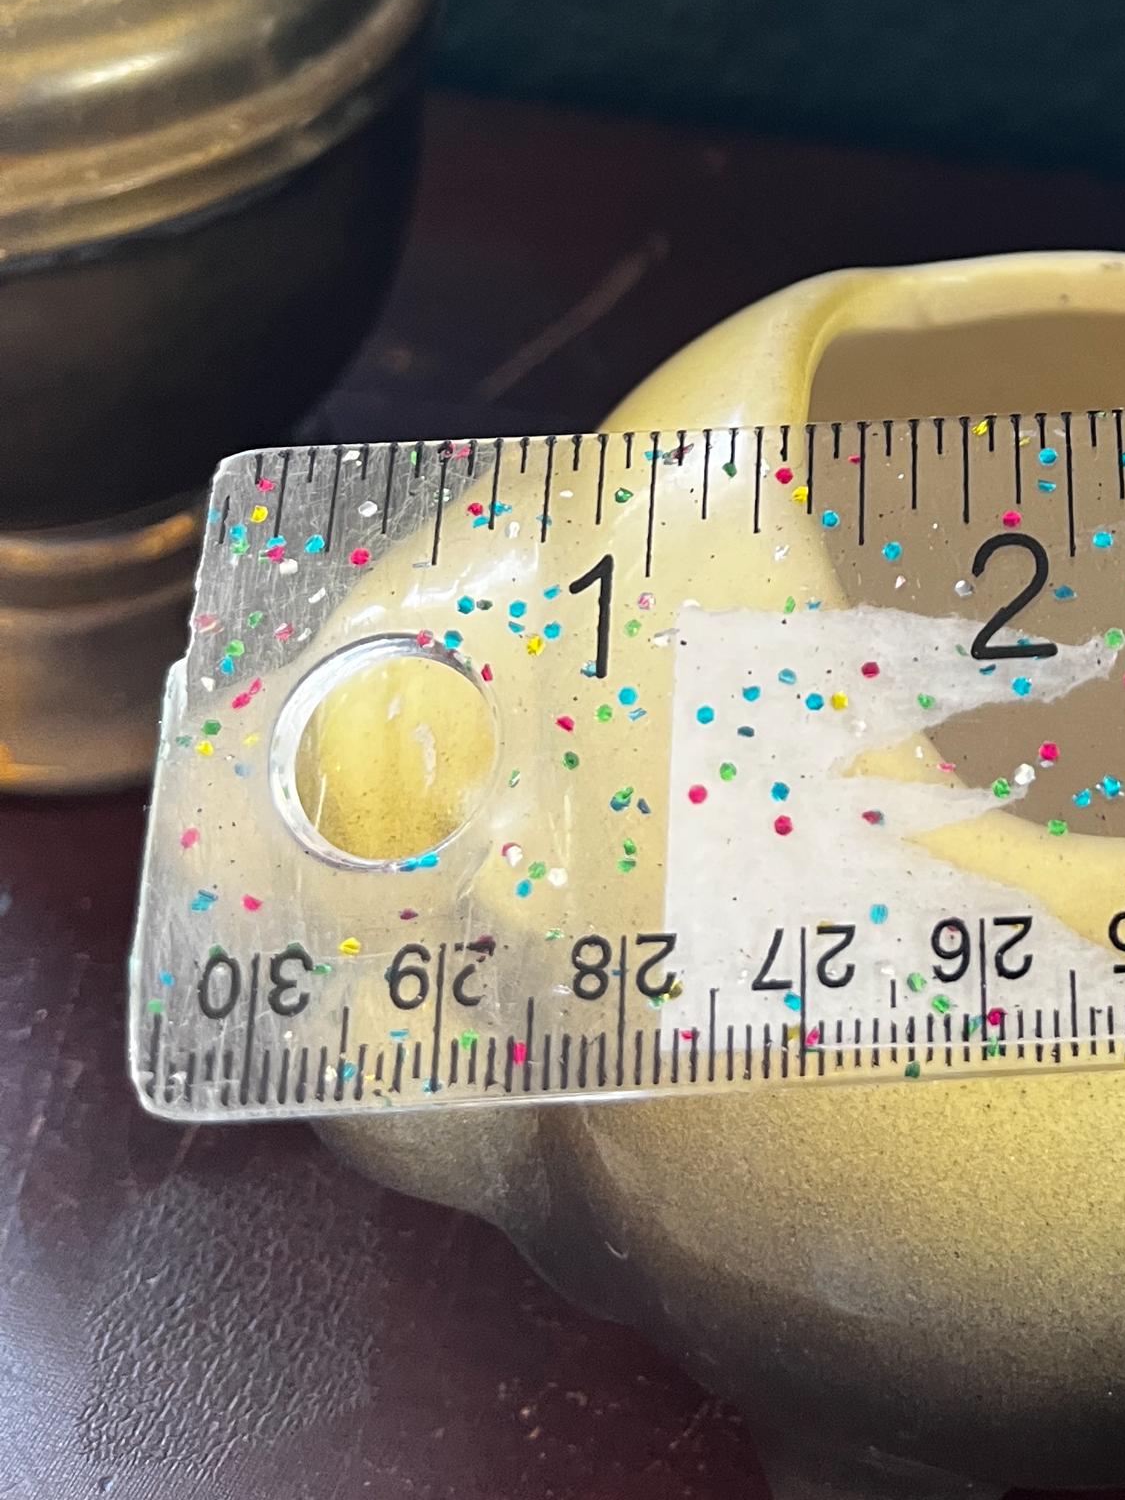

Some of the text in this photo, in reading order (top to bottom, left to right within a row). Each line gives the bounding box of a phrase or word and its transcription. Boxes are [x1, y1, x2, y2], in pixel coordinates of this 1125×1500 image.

[568, 554, 615, 678] 1
[970, 533, 1057, 658] 2
[199, 943, 314, 1020] 30
[389, 935, 496, 1010] 29
[571, 932, 677, 999] 28
[751, 925, 857, 992] 27
[930, 916, 1034, 983] 26
